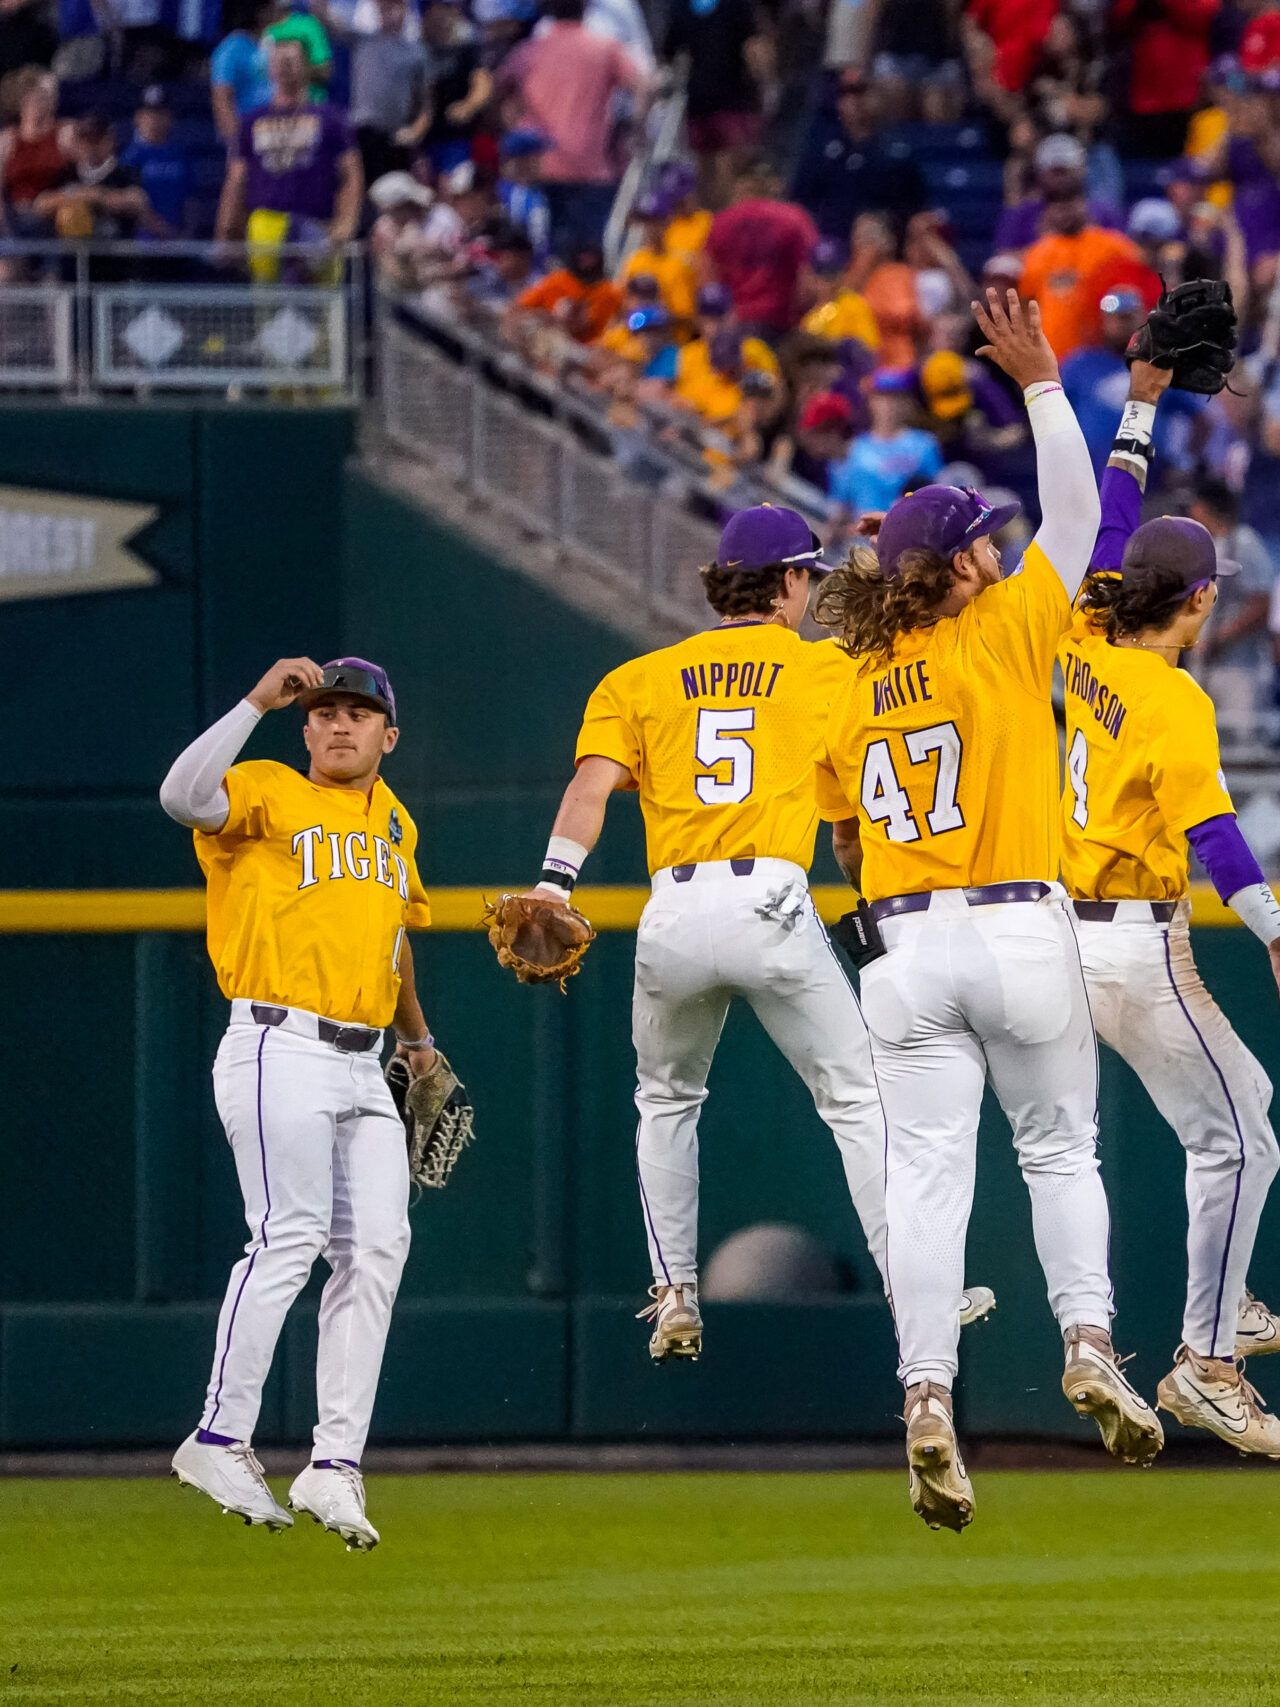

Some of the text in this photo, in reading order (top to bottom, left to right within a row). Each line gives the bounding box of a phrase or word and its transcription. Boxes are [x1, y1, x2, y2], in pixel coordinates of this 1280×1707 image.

[681, 661, 784, 700] NIPPOLT
[873, 660, 932, 716] WHITE
[1065, 652, 1127, 741] THOMSON
[695, 707, 755, 805] 5
[860, 720, 966, 843] 47
[1068, 727, 1088, 831] 4
[852, 916, 868, 946] marucci
